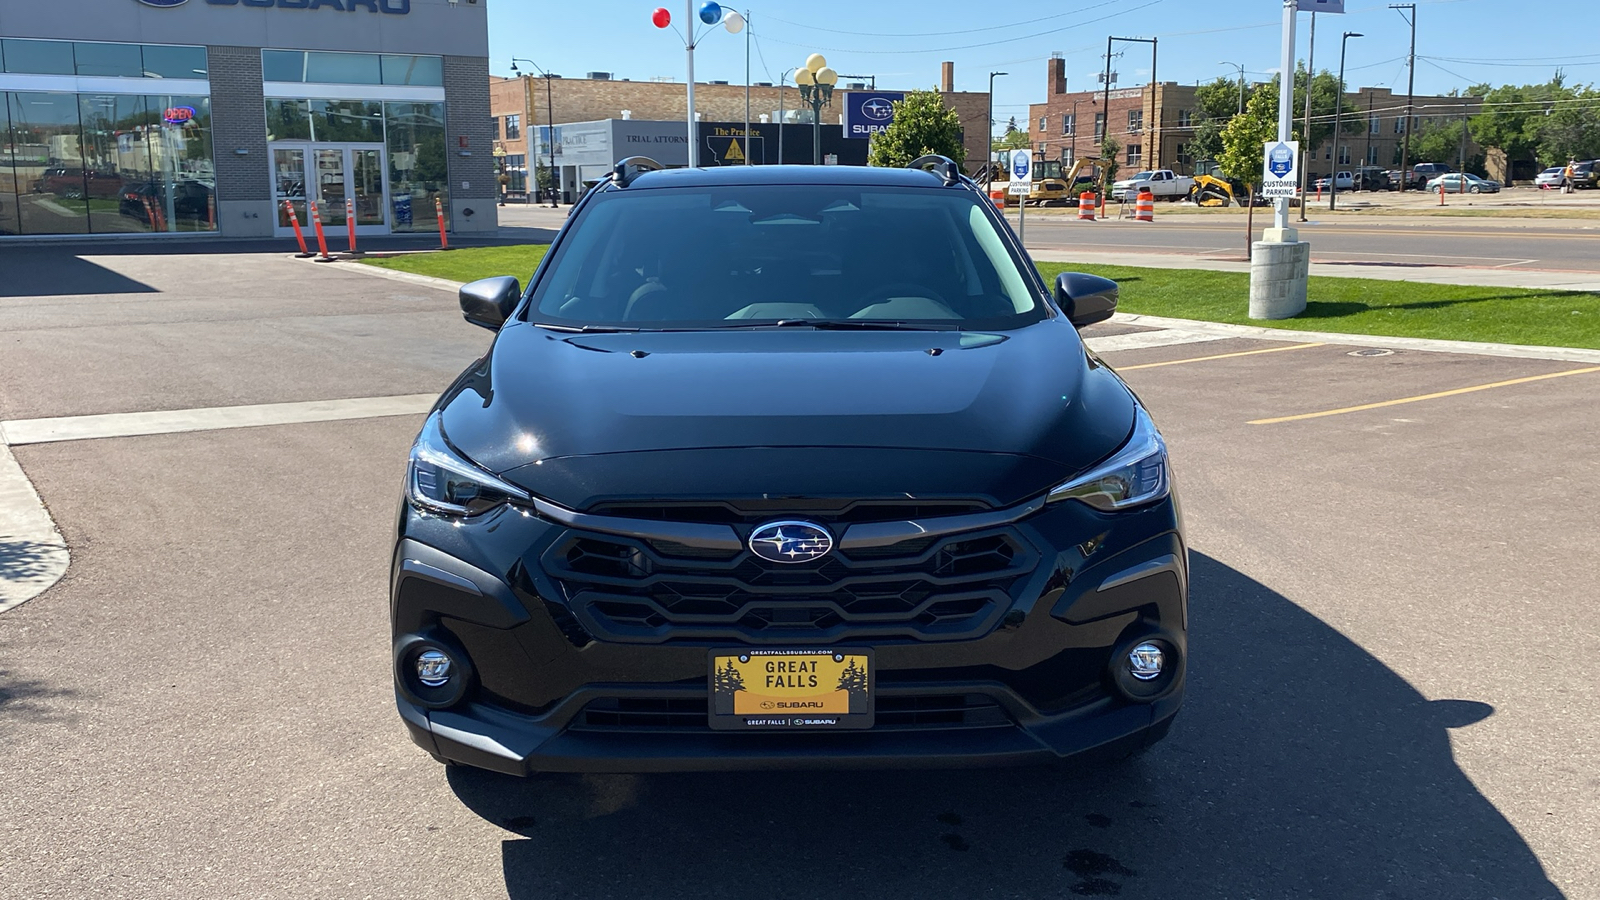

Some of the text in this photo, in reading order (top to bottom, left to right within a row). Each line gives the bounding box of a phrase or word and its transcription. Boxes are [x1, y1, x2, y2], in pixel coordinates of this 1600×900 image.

[164, 108, 193, 119] OPEN
[714, 127, 760, 137] The Pracice
[852, 124, 893, 133] SUBA
[626, 135, 651, 143] TRIAL
[765, 661, 818, 673] GREAT
[765, 675, 818, 688] FALLS
